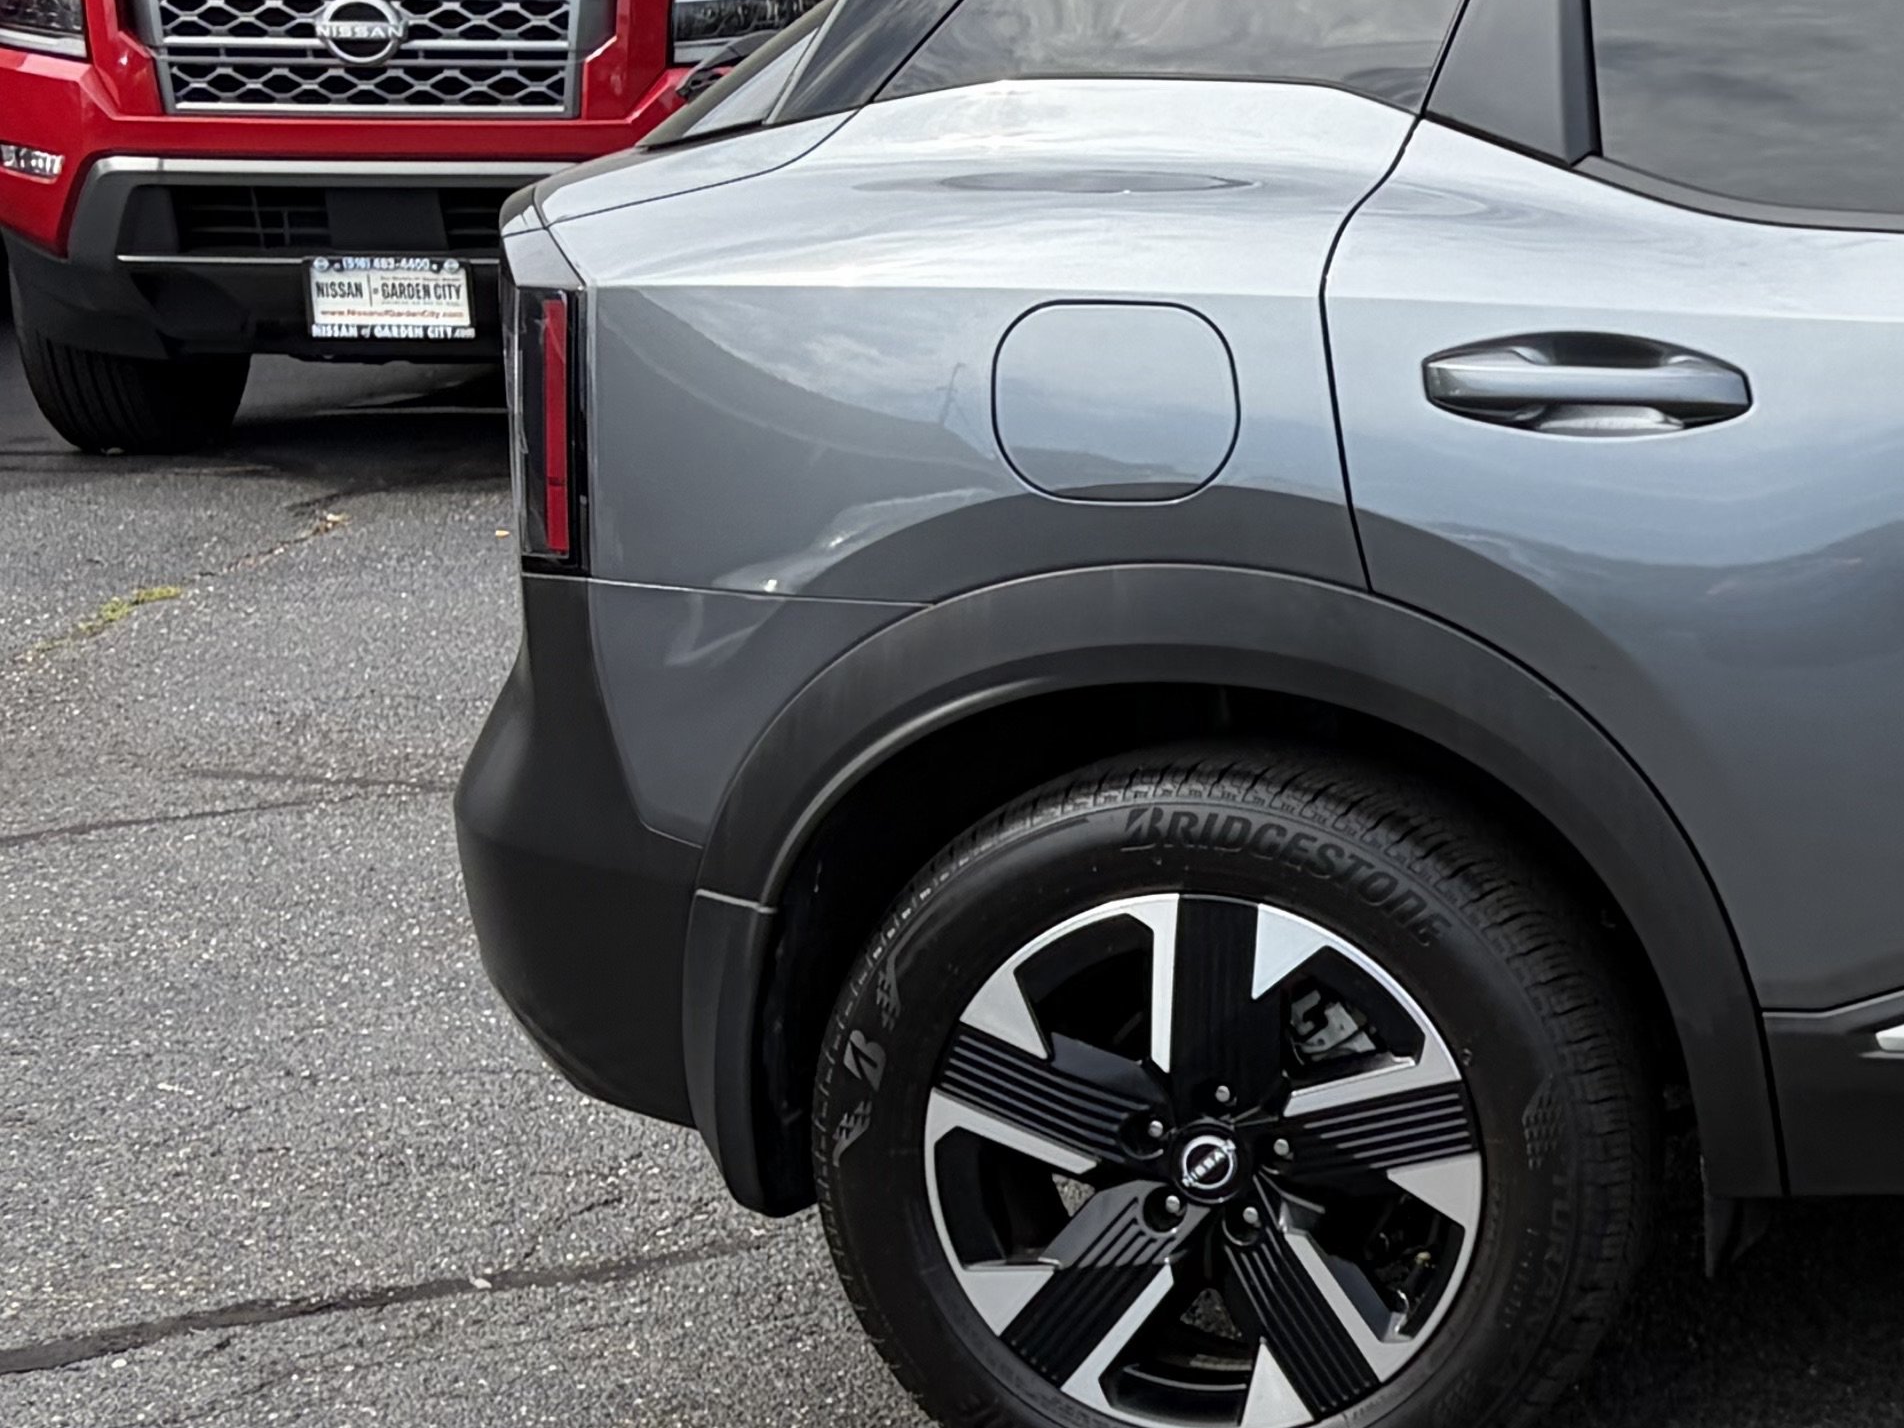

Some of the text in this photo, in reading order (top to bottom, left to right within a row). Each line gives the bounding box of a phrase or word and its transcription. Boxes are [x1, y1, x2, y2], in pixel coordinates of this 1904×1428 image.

[315, 20, 404, 39] NISSAN
[316, 281, 364, 299] NISSAN
[381, 282, 432, 301] GARDEN
[433, 283, 462, 301] CITY
[311, 323, 358, 339] NISSAN
[374, 325, 424, 339] GARDEN
[1123, 807, 1453, 947] BRIDGESTONE
[1182, 1138, 1237, 1188] NISSAN
